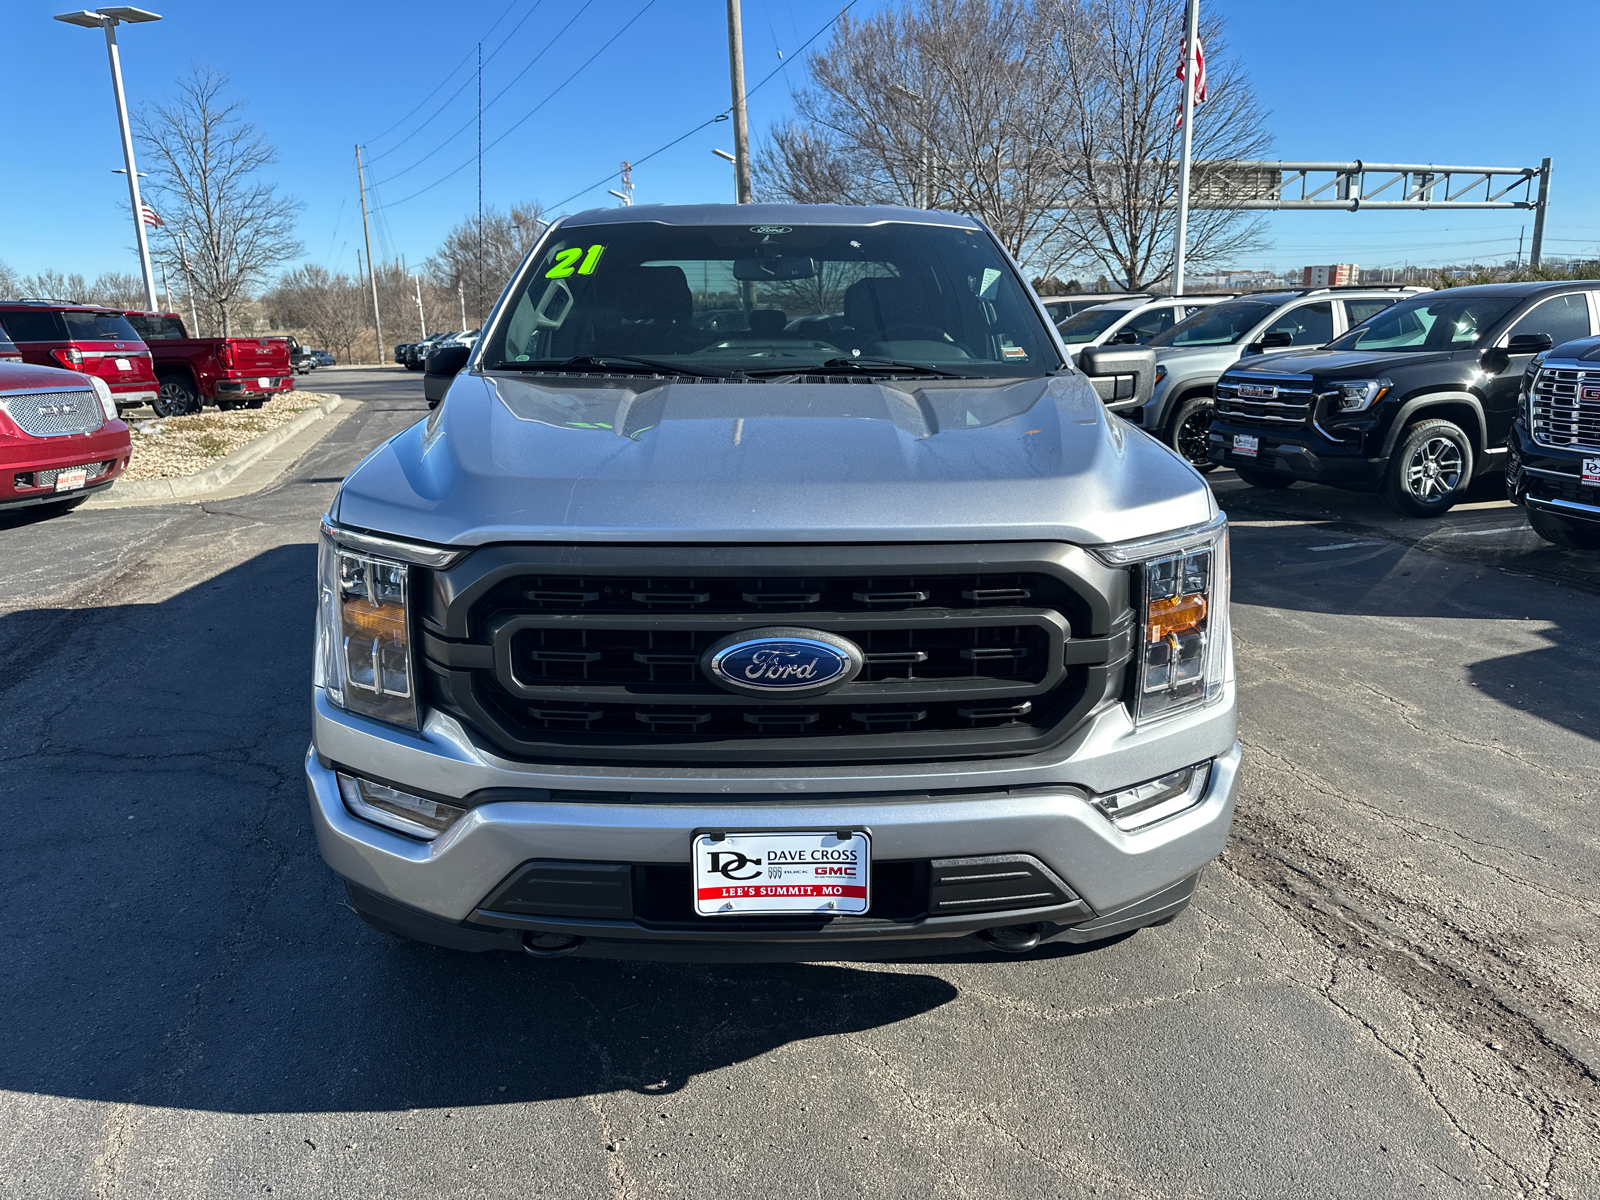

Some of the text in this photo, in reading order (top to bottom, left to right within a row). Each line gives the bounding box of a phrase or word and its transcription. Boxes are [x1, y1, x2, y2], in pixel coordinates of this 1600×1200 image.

[545, 244, 605, 279] 21
[57, 474, 86, 484] DAVE CROSS
[745, 649, 819, 679] Ford
[767, 849, 858, 861] DAVE CROSS
[814, 866, 857, 876] GMC
[722, 886, 843, 897] LEE'S SUMMIT, MO
